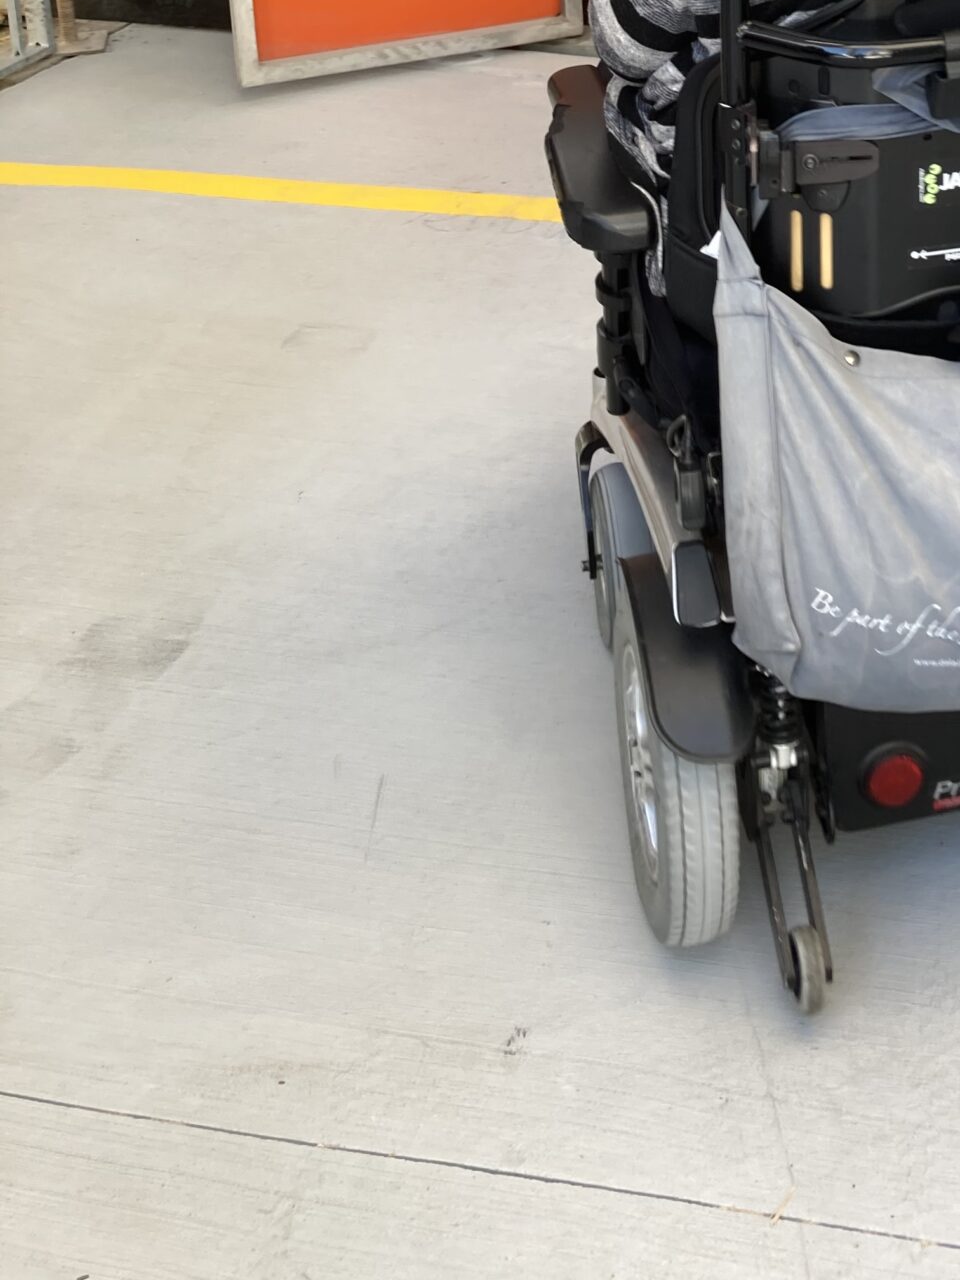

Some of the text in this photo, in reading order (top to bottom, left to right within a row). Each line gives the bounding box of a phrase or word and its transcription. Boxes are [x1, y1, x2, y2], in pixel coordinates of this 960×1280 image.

[811, 587, 843, 617] Be
[829, 608, 892, 637] part
[874, 604, 941, 656] of
